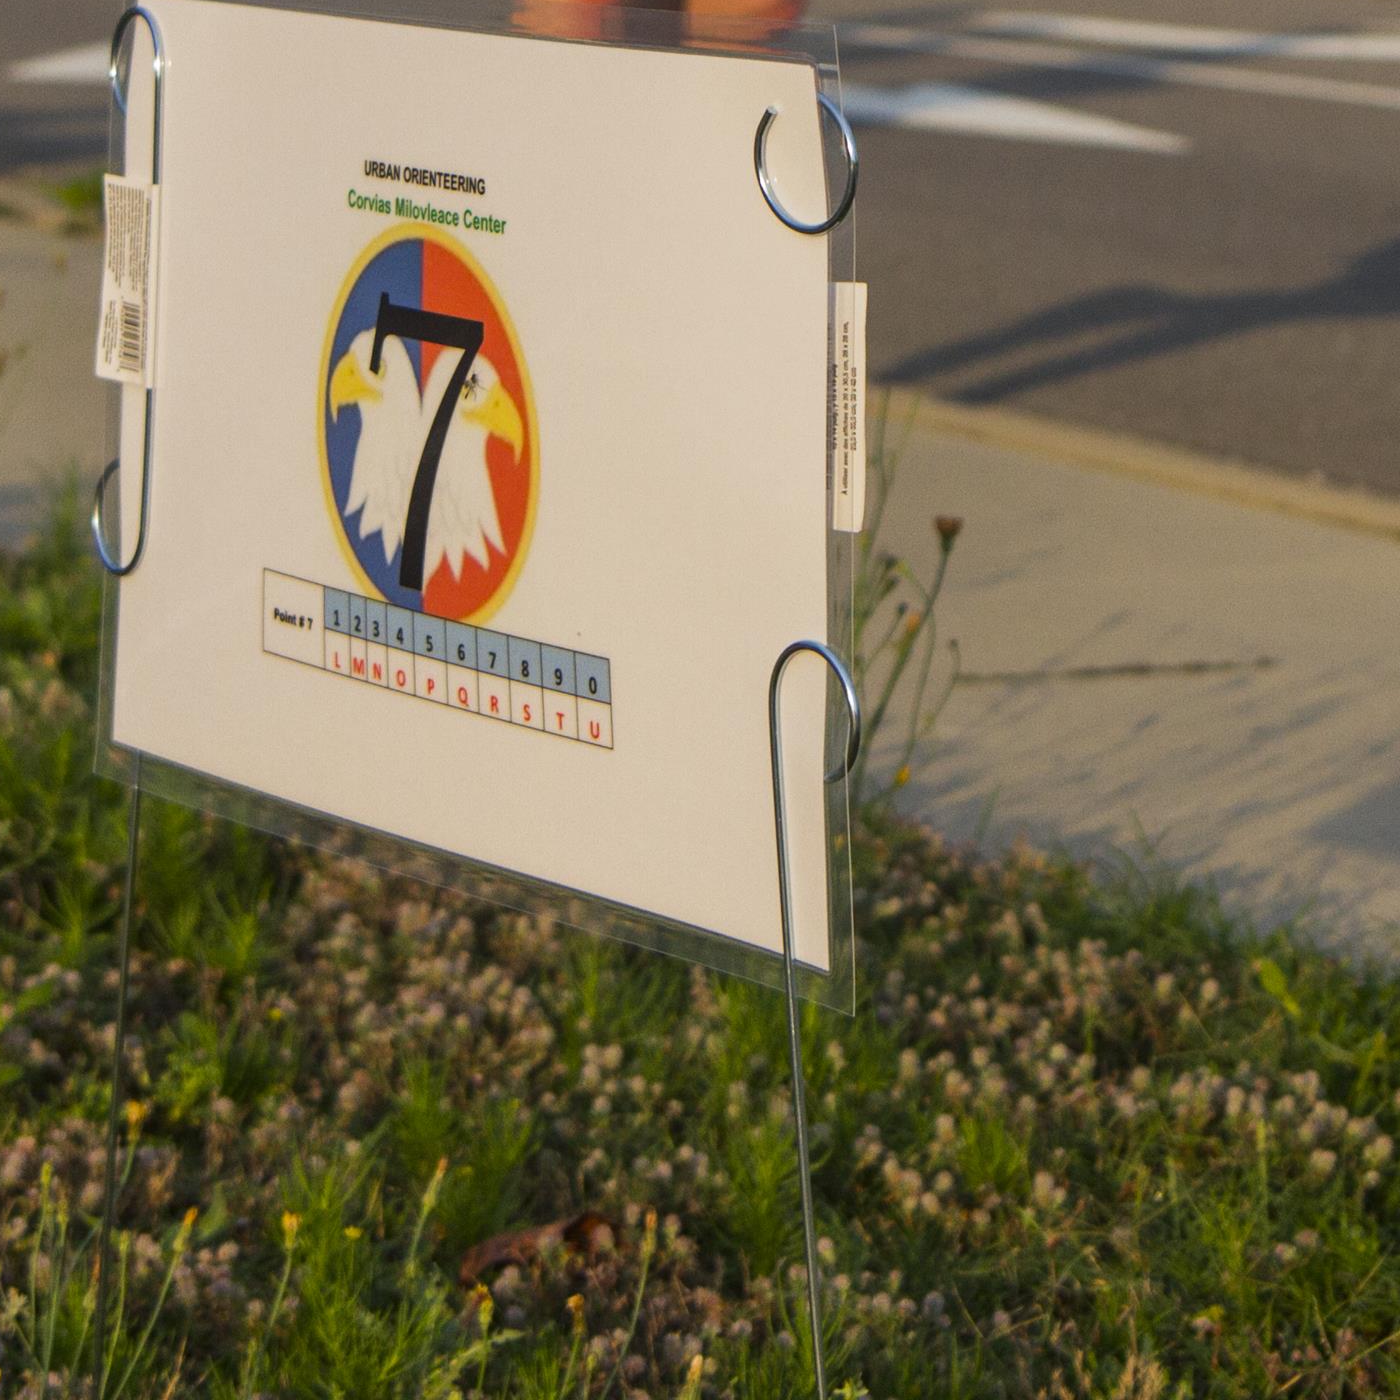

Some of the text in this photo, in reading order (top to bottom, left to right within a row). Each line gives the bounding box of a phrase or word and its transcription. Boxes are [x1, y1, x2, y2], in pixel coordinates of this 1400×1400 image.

[347, 188, 392, 215] Corvias
[463, 208, 508, 235] Center
[363, 159, 486, 196] URBAN ORIENTEERING
[369, 291, 485, 591] 7
[273, 607, 297, 626] Point
[307, 616, 313, 631] 7
[333, 609, 340, 626] 1
[354, 615, 362, 633] 2
[373, 620, 380, 637] 3
[396, 627, 404, 645] 4
[425, 635, 434, 653] 5
[457, 643, 466, 662] 6
[488, 652, 497, 670] 7
[521, 660, 530, 678] 8
[554, 668, 563, 686] 9
[588, 676, 598, 695] 0
[334, 652, 600, 739] L M N O P Q R S T U
